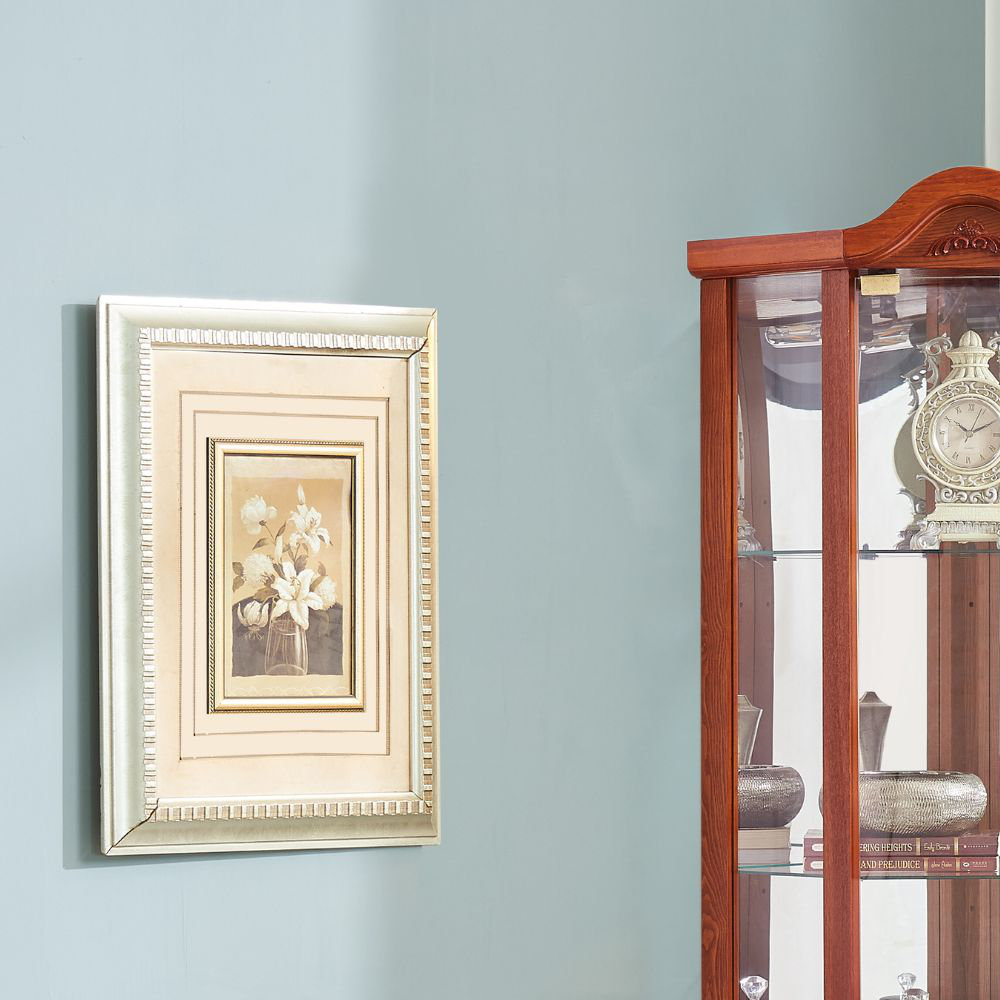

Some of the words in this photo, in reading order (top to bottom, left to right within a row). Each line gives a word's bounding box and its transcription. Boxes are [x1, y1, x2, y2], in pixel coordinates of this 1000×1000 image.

[860, 843, 880, 852] ERING
[881, 843, 913, 852] HEIGHTS
[860, 860, 877, 869] AND
[878, 860, 921, 869] PREJUDICE
